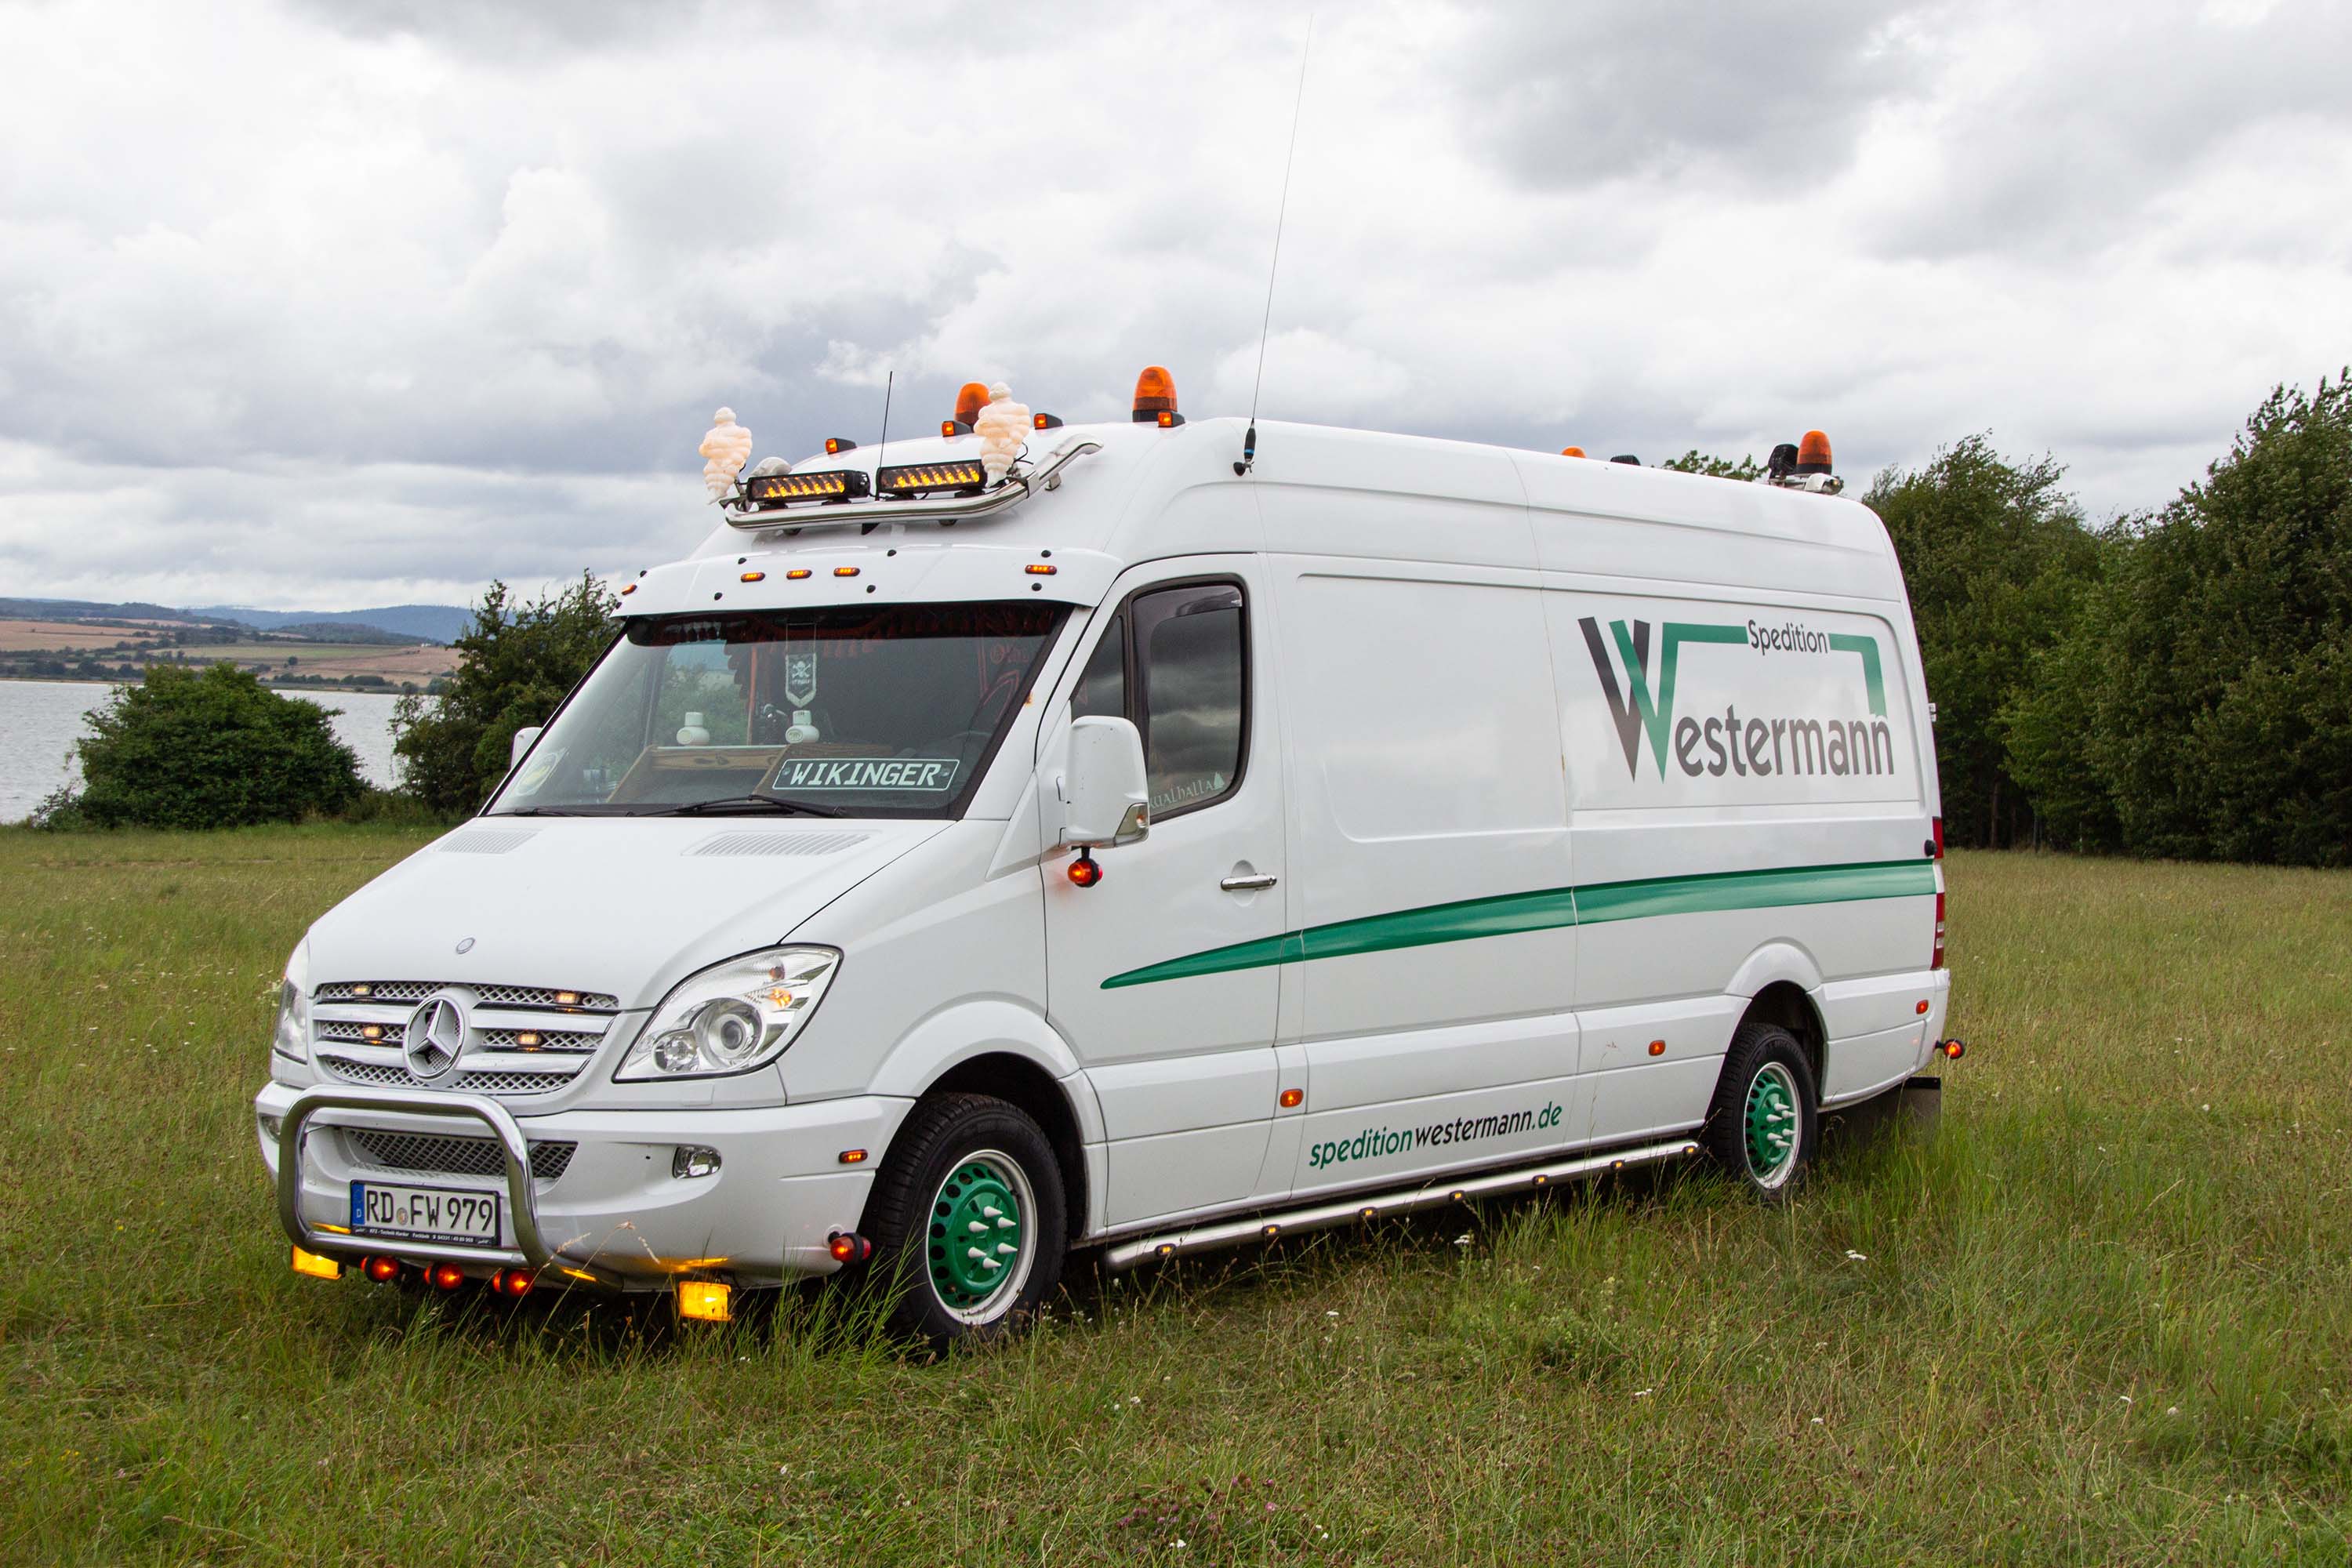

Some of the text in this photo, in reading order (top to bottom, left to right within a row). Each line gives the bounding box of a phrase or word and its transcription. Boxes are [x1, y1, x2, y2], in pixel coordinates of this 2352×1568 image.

[1748, 619, 1829, 655] Spedition
[1577, 616, 1894, 784] Westermann
[789, 763, 941, 786] WIKINGER
[1308, 1102, 1563, 1169] speditionwestermann.de
[366, 1190, 493, 1231] RD FW 979
